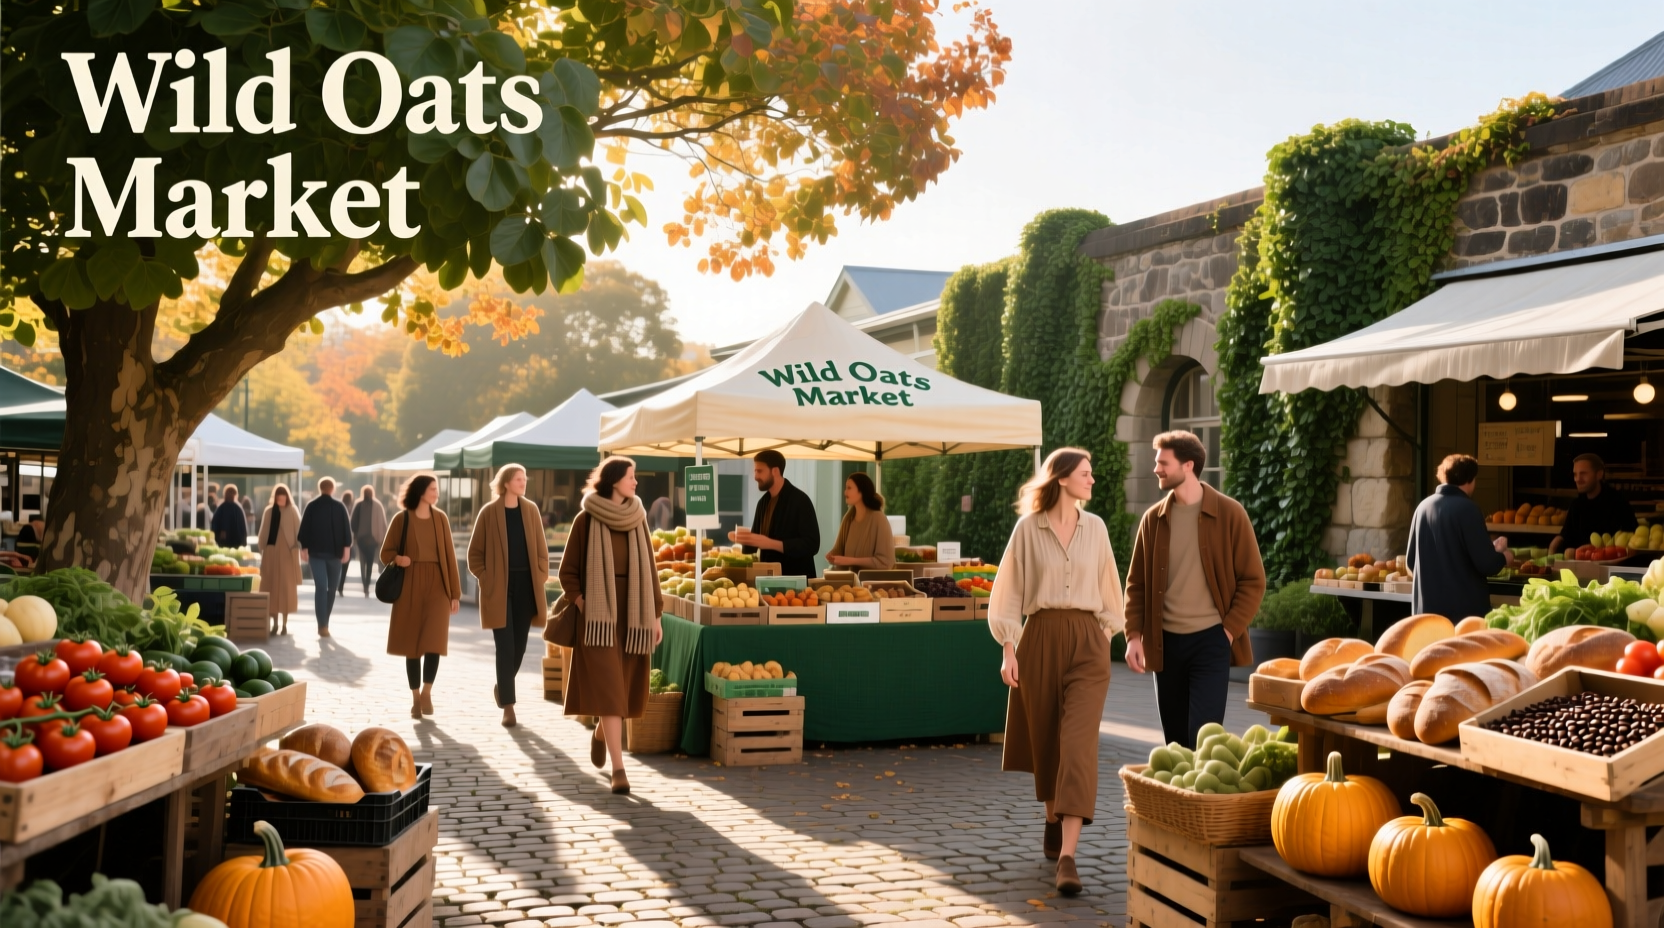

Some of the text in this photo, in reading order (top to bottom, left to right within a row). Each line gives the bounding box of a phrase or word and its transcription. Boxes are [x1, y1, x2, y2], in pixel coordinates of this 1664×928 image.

[757, 360, 931, 391] Wild Oats
[792, 385, 914, 407] Market
